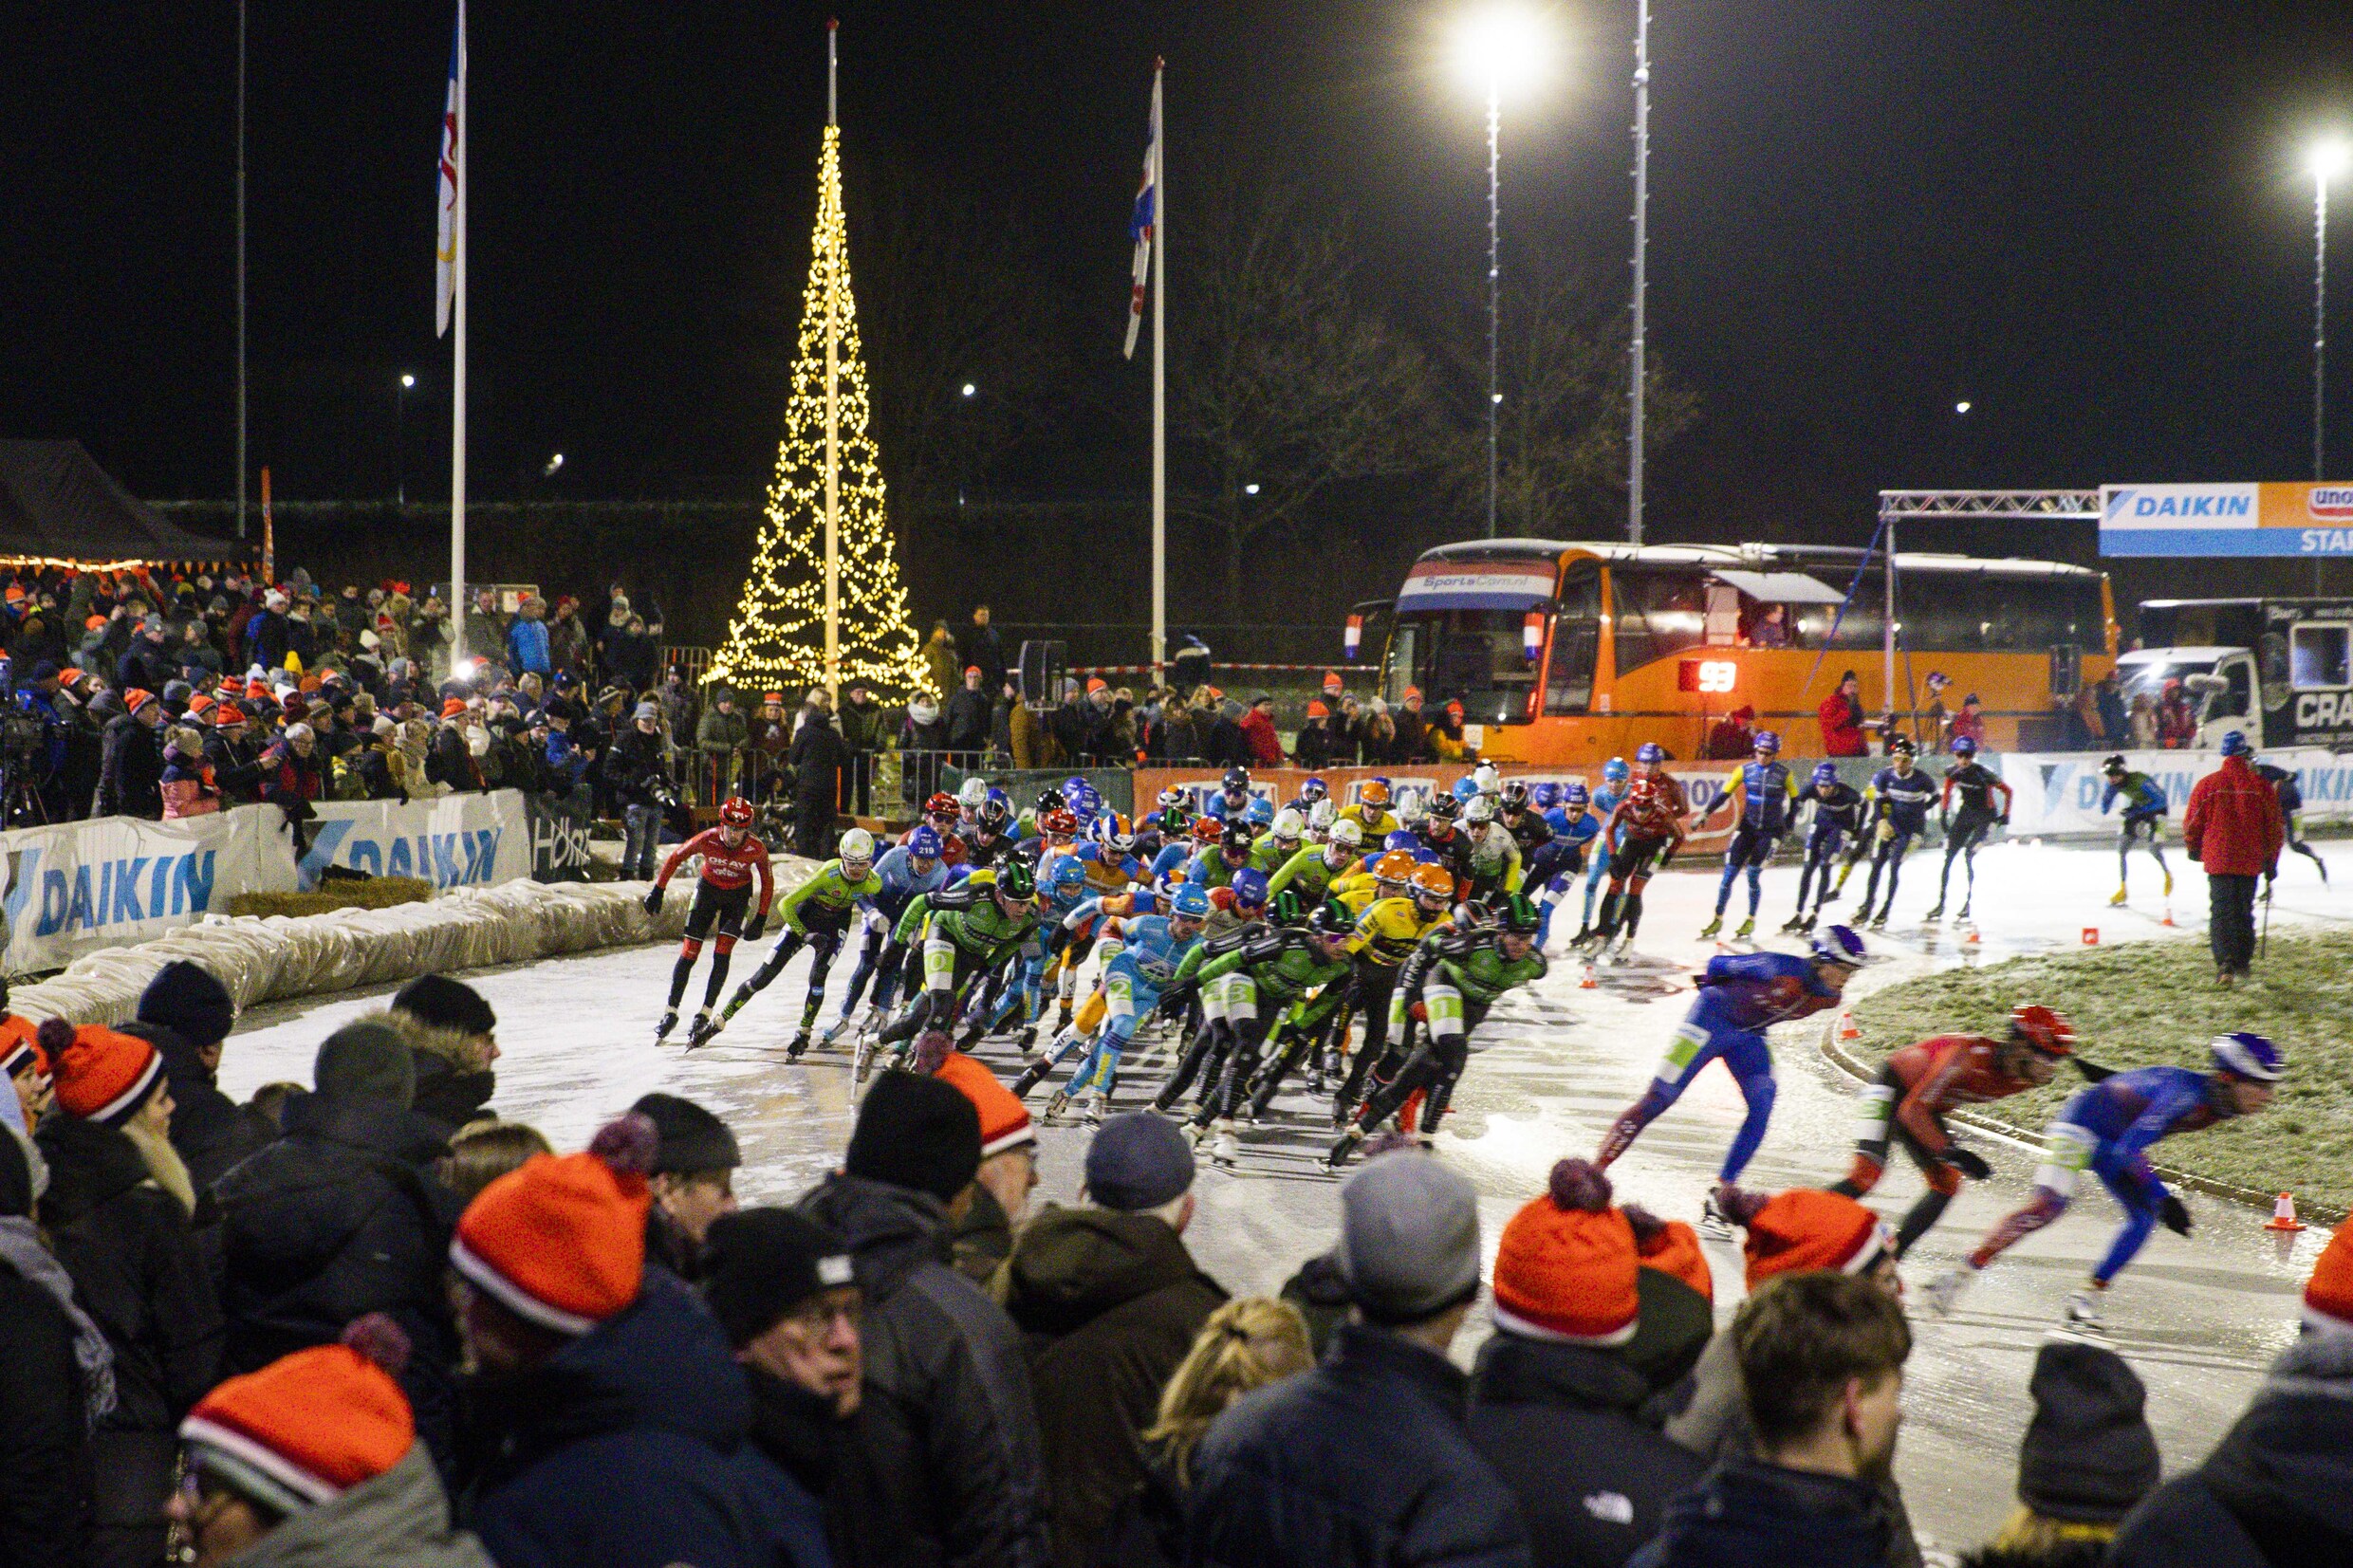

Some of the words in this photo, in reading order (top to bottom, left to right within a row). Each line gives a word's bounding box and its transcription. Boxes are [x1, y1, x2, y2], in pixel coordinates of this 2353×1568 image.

[2136, 495, 2251, 517] DAIKIN
[1698, 661, 1736, 692] 93
[349, 826, 503, 890] DAIKIN
[35, 850, 216, 936] DAIKIN
